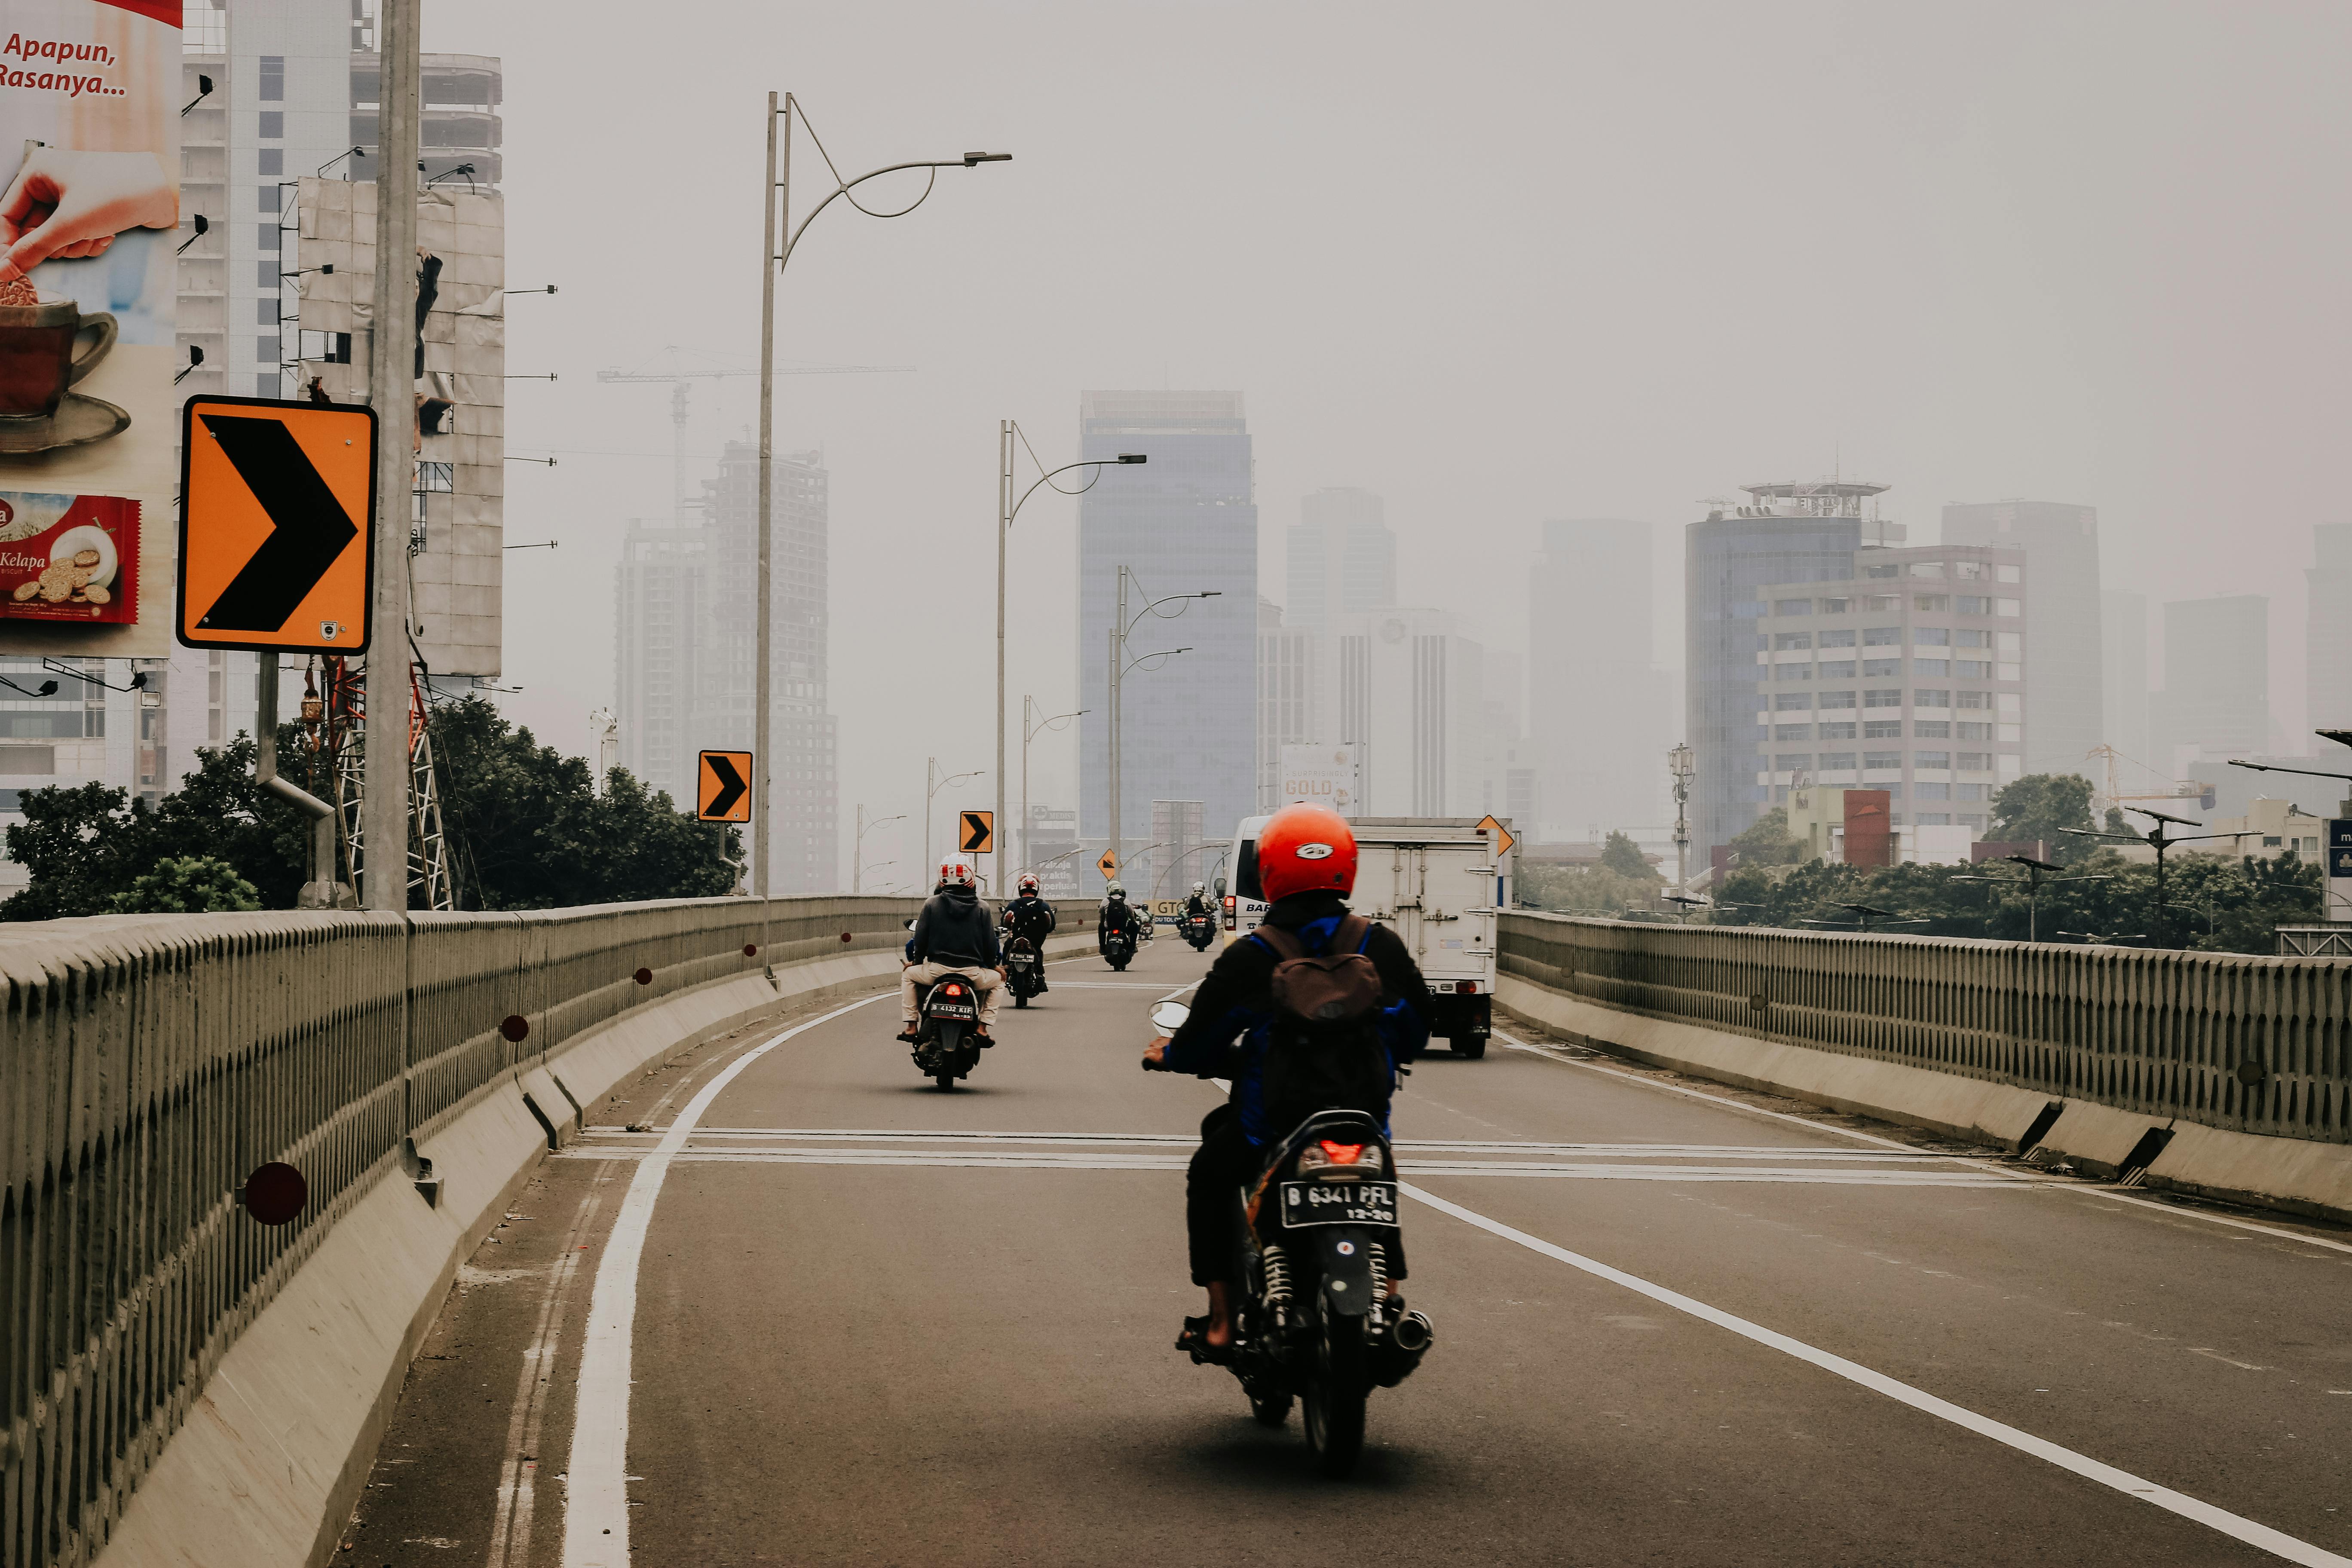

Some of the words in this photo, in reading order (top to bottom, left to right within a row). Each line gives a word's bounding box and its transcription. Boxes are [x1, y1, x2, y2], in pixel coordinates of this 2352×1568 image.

[3, 33, 115, 66] Apapun,
[0, 64, 125, 98] Rasanya...
[0, 552, 45, 572] Kelapa
[1286, 780, 1332, 795] GOLD
[1288, 1187, 1301, 1206] B
